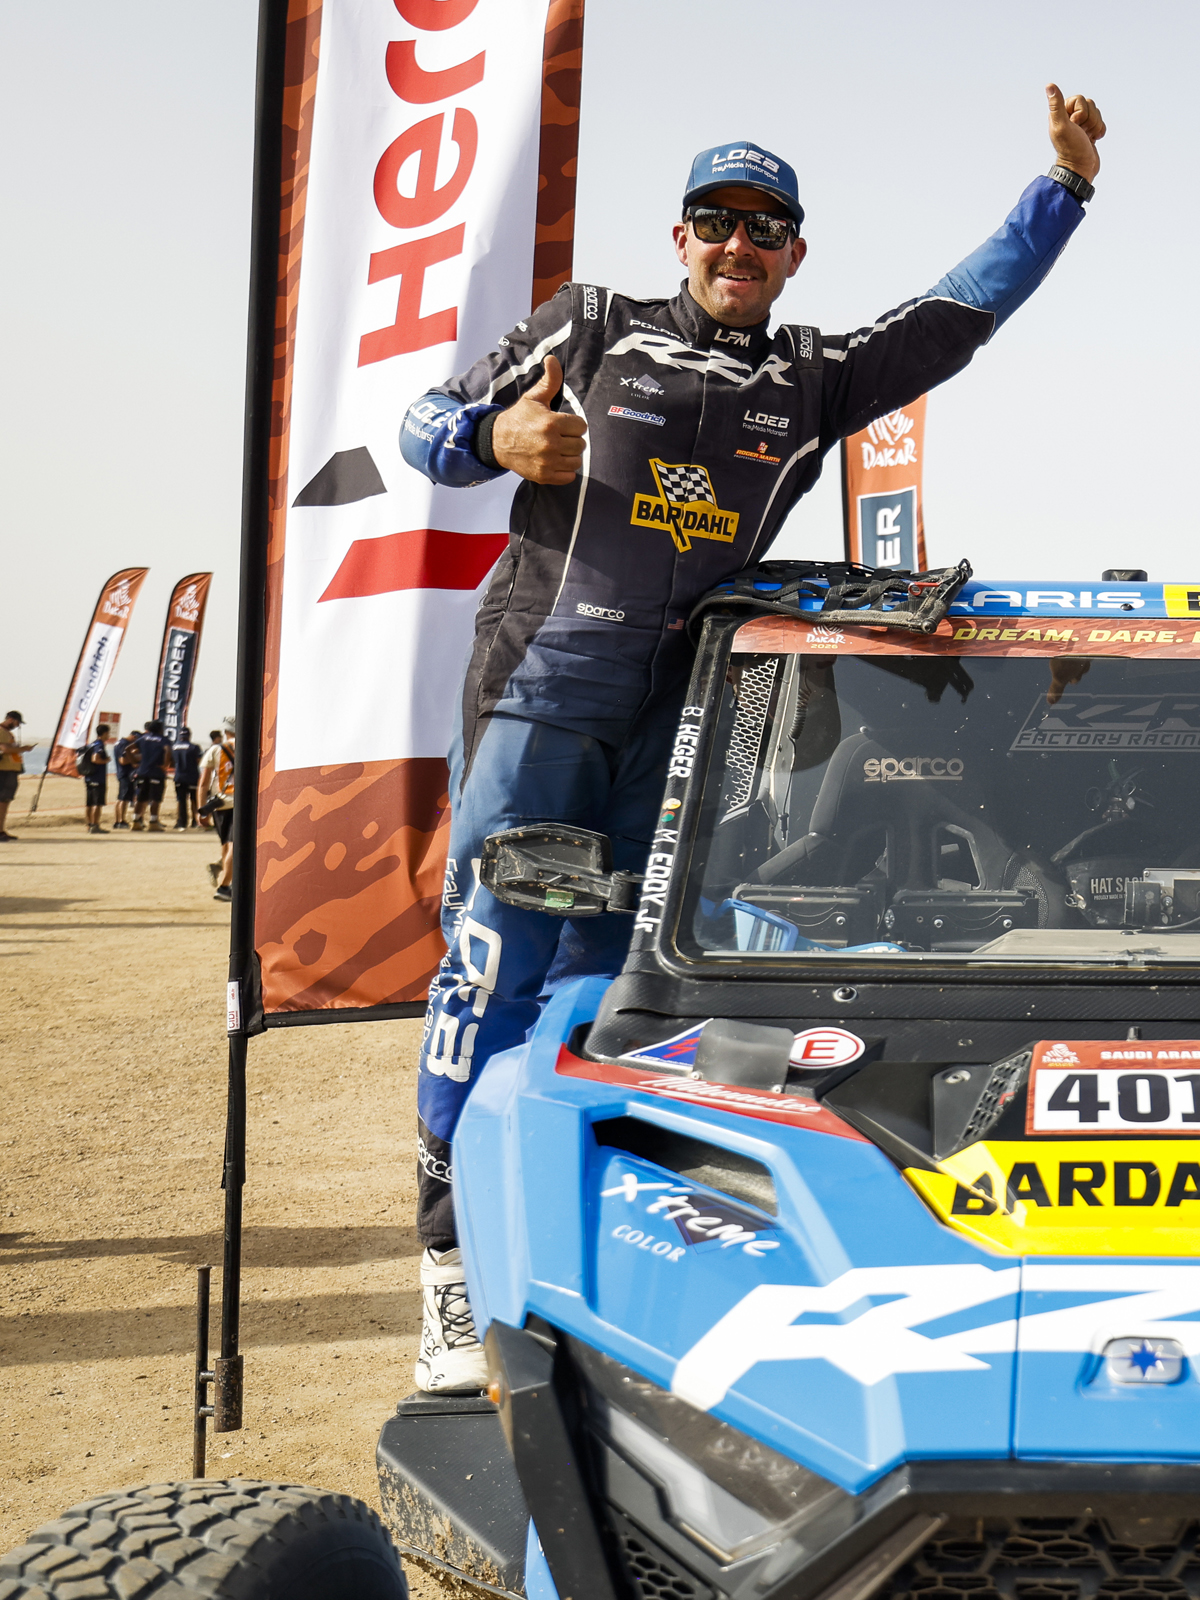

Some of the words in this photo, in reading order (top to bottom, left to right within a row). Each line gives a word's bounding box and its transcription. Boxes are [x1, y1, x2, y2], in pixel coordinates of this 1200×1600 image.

[711, 148, 780, 174] LOEB
[745, 162, 780, 184] Motorsport
[356, 0, 486, 368] Her
[583, 285, 598, 320] sparco
[714, 328, 752, 348] LFM
[604, 332, 795, 387] RZR
[610, 406, 666, 424] BFGoodrich
[743, 409, 790, 429] LOEB
[860, 438, 918, 470] DAKAR
[636, 500, 735, 538] BARDAHL
[102, 600, 130, 619] DAKAR
[174, 606, 200, 622] DAKAR
[576, 602, 625, 621] sparco
[805, 632, 847, 645] DAKAR
[953, 627, 1080, 643] DREAM.
[1087, 629, 1183, 644] DARE.
[163, 634, 189, 741] DEFENDER
[1017, 732, 1123, 745] FACTORY
[667, 723, 702, 780] HEGER
[863, 755, 965, 783] sparco
[639, 852, 675, 907] EDDY
[1090, 877, 1113, 894] HAT
[634, 908, 662, 933] Jr
[801, 1039, 839, 1060] E
[1041, 1055, 1081, 1064] DAKAR
[1100, 1050, 1153, 1060] SAUDI
[611, 1223, 687, 1263] COLOR
